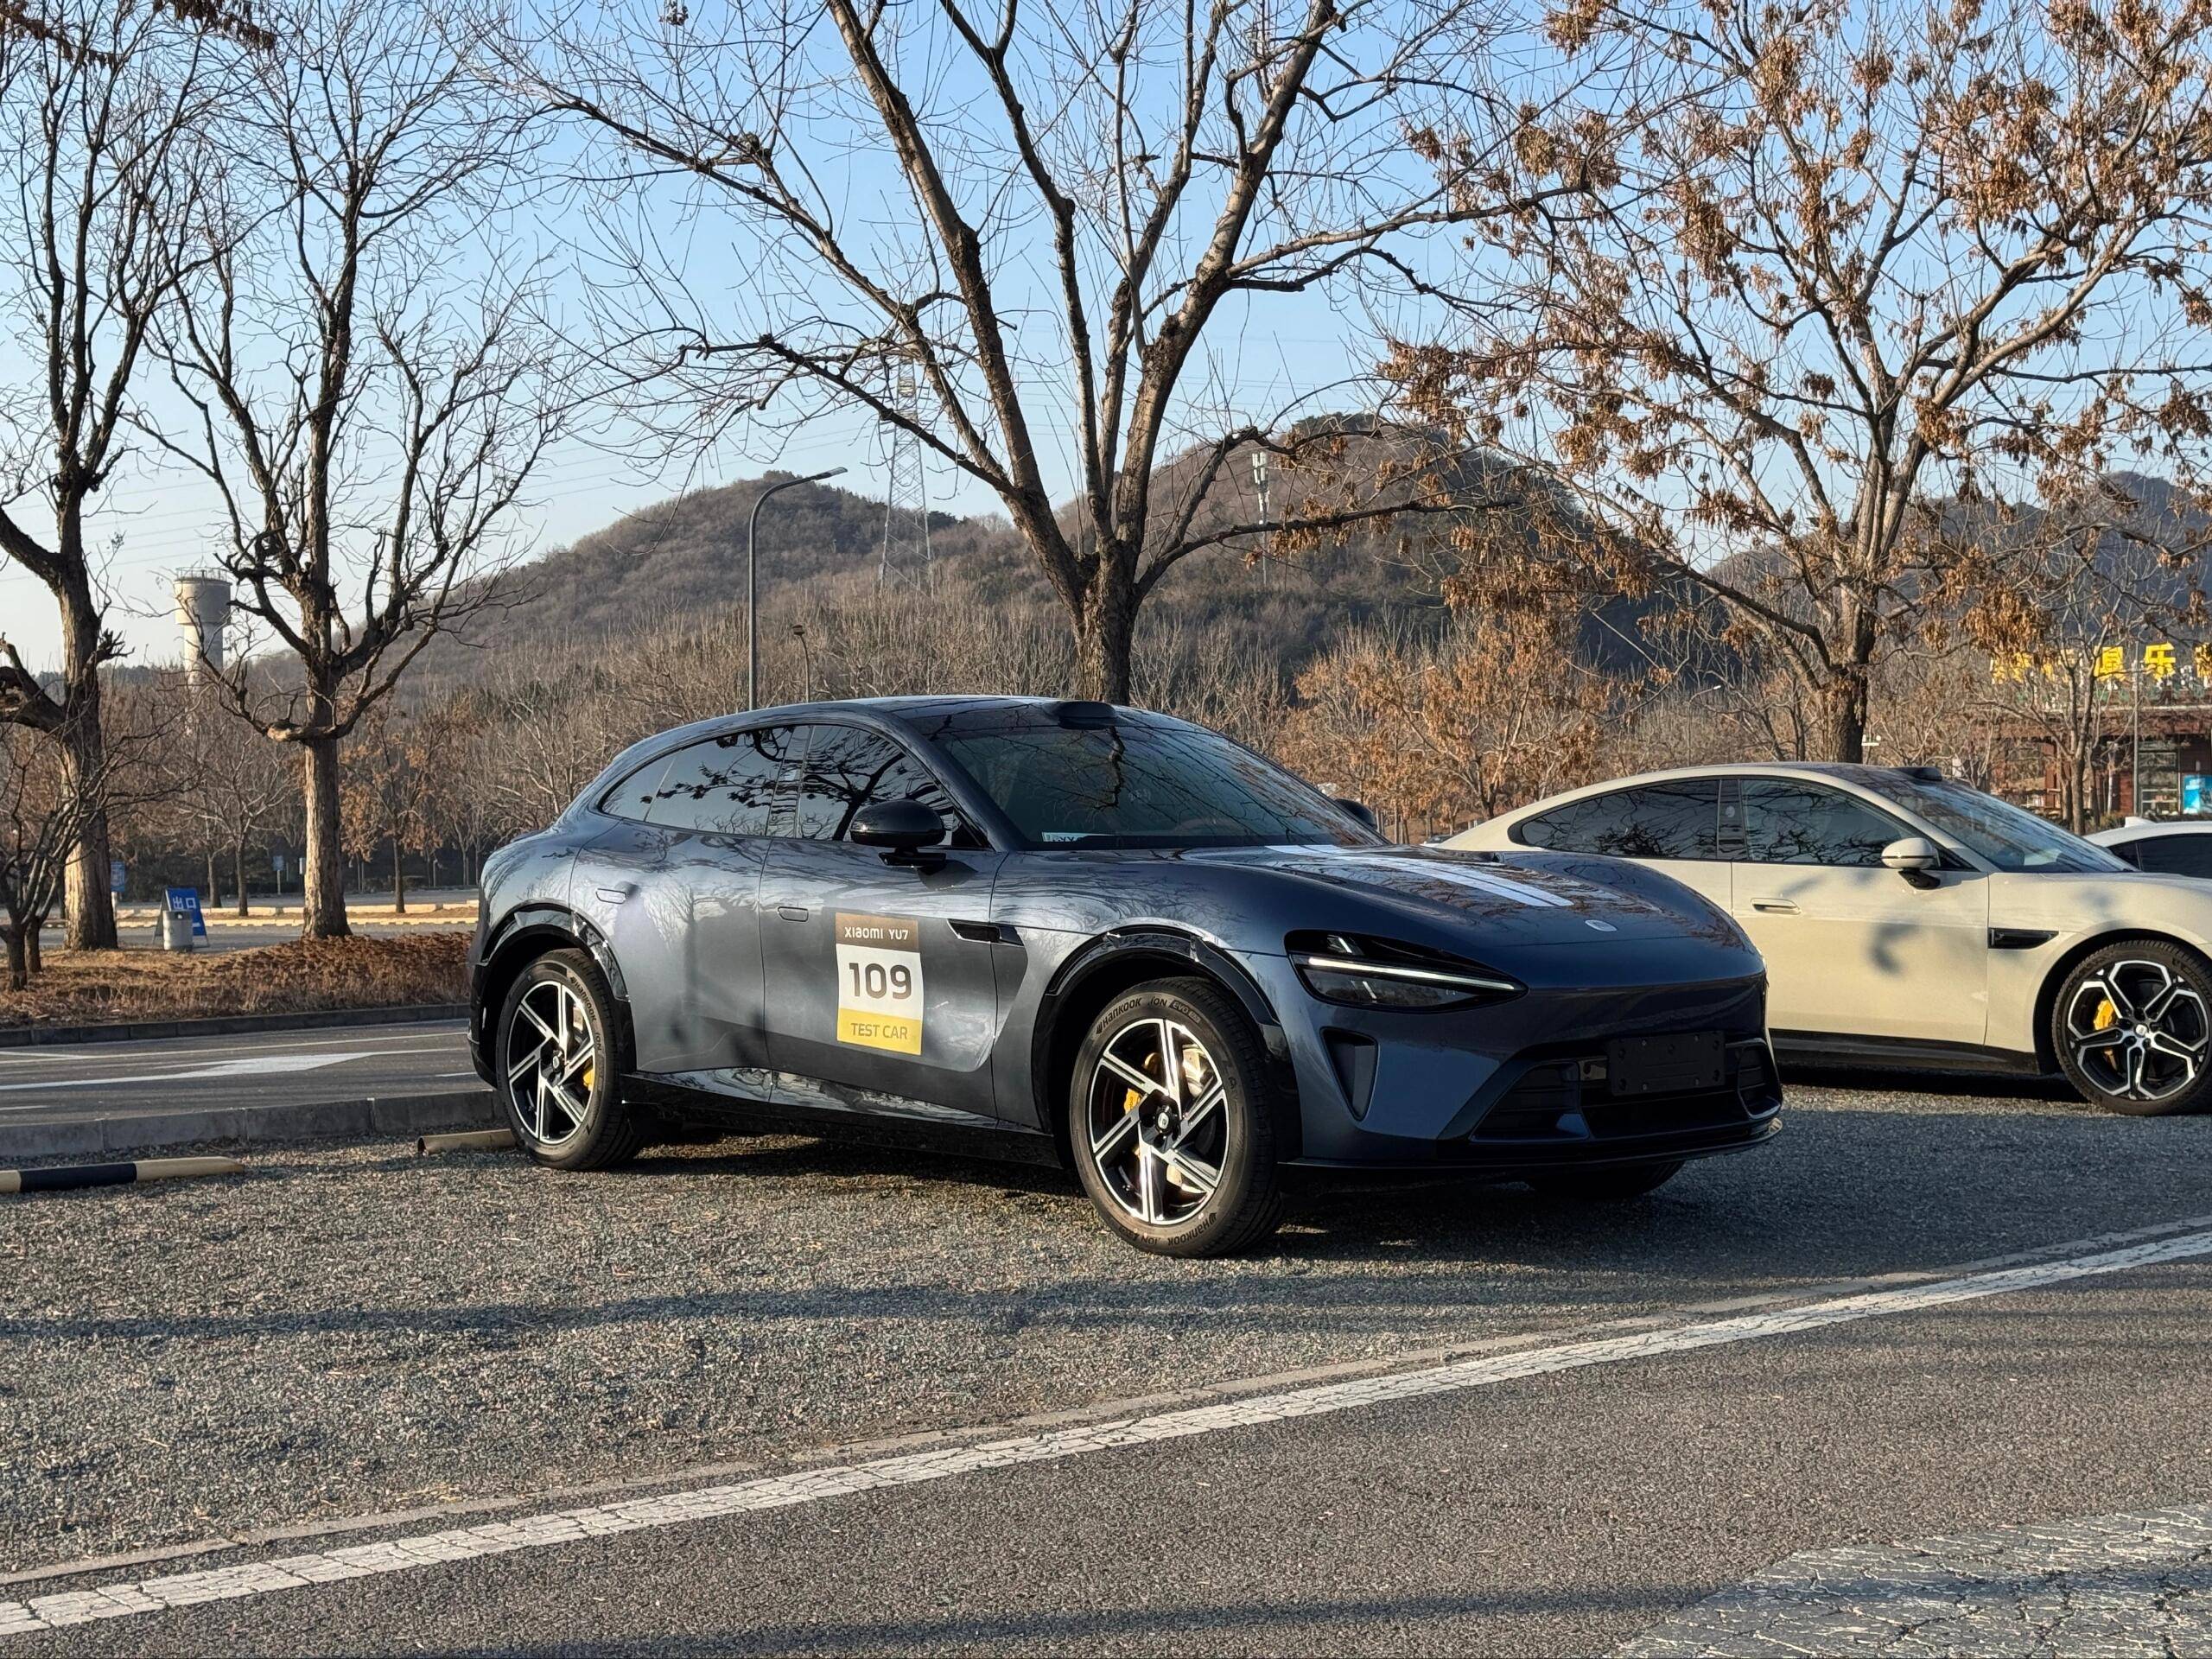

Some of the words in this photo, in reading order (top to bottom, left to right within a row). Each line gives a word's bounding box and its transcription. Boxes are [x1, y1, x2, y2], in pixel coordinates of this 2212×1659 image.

[172, 896, 197, 910] 出口
[888, 928, 909, 940] YU7
[849, 963, 912, 1000] 109
[850, 1022, 880, 1038] TEST
[882, 1025, 908, 1039] CAR
